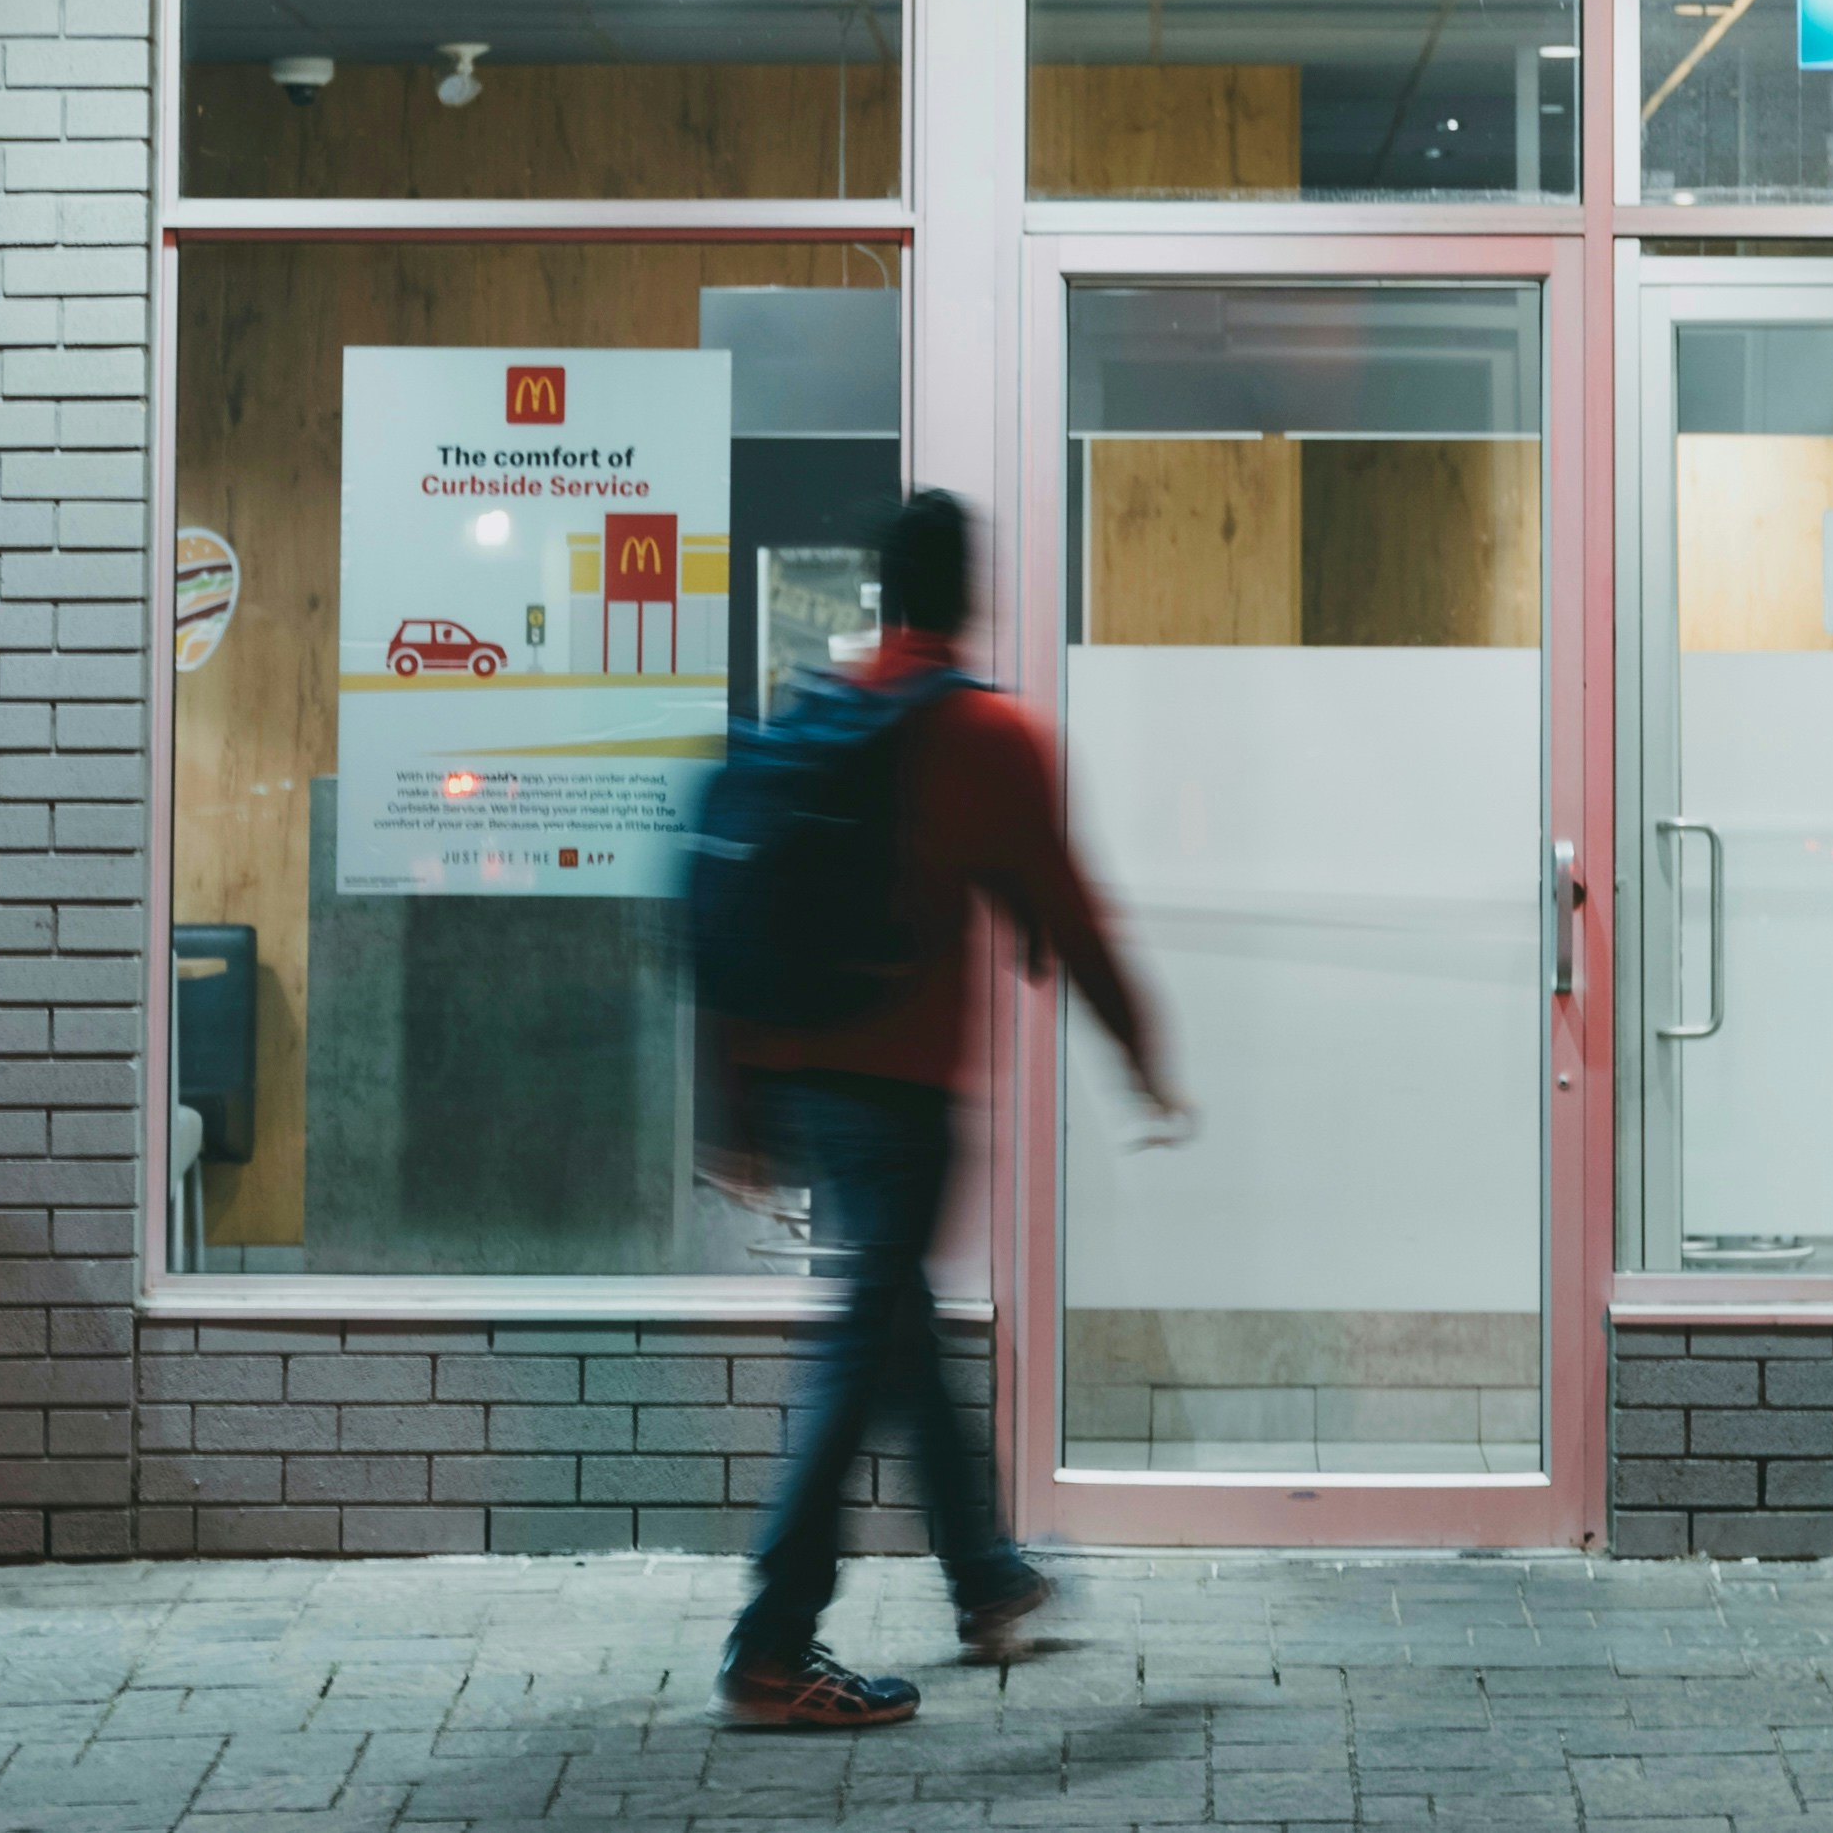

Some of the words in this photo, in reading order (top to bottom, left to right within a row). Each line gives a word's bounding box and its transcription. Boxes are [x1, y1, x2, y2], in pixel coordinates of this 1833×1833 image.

[438, 445, 487, 468] The
[493, 445, 602, 468] comfort
[607, 445, 635, 468] of
[421, 473, 542, 497] Curbside
[550, 475, 650, 497] Service
[396, 771, 423, 783] With
[426, 771, 446, 783] the
[547, 775, 569, 787] you
[571, 775, 593, 784] can
[595, 773, 625, 784] order
[397, 788, 429, 799] make
[508, 789, 562, 802] payment
[567, 789, 587, 800] and
[589, 790, 613, 802] pick
[616, 792, 632, 802] up
[634, 790, 667, 803] using
[387, 802, 440, 815] Curbside
[519, 804, 549, 817] bring
[552, 806, 578, 818] your
[580, 805, 609, 816] meal
[611, 805, 638, 819] right
[641, 806, 654, 817] to
[656, 806, 676, 818] the
[373, 818, 421, 831] comfort
[423, 818, 435, 831] of
[437, 821, 462, 834] your
[543, 822, 564, 834] you
[567, 820, 613, 832] deserve
[615, 822, 623, 832] a
[625, 820, 651, 832] little
[442, 851, 479, 866] JUST
[486, 851, 514, 866] USE
[523, 851, 550, 866] THE
[586, 851, 615, 866] APP
